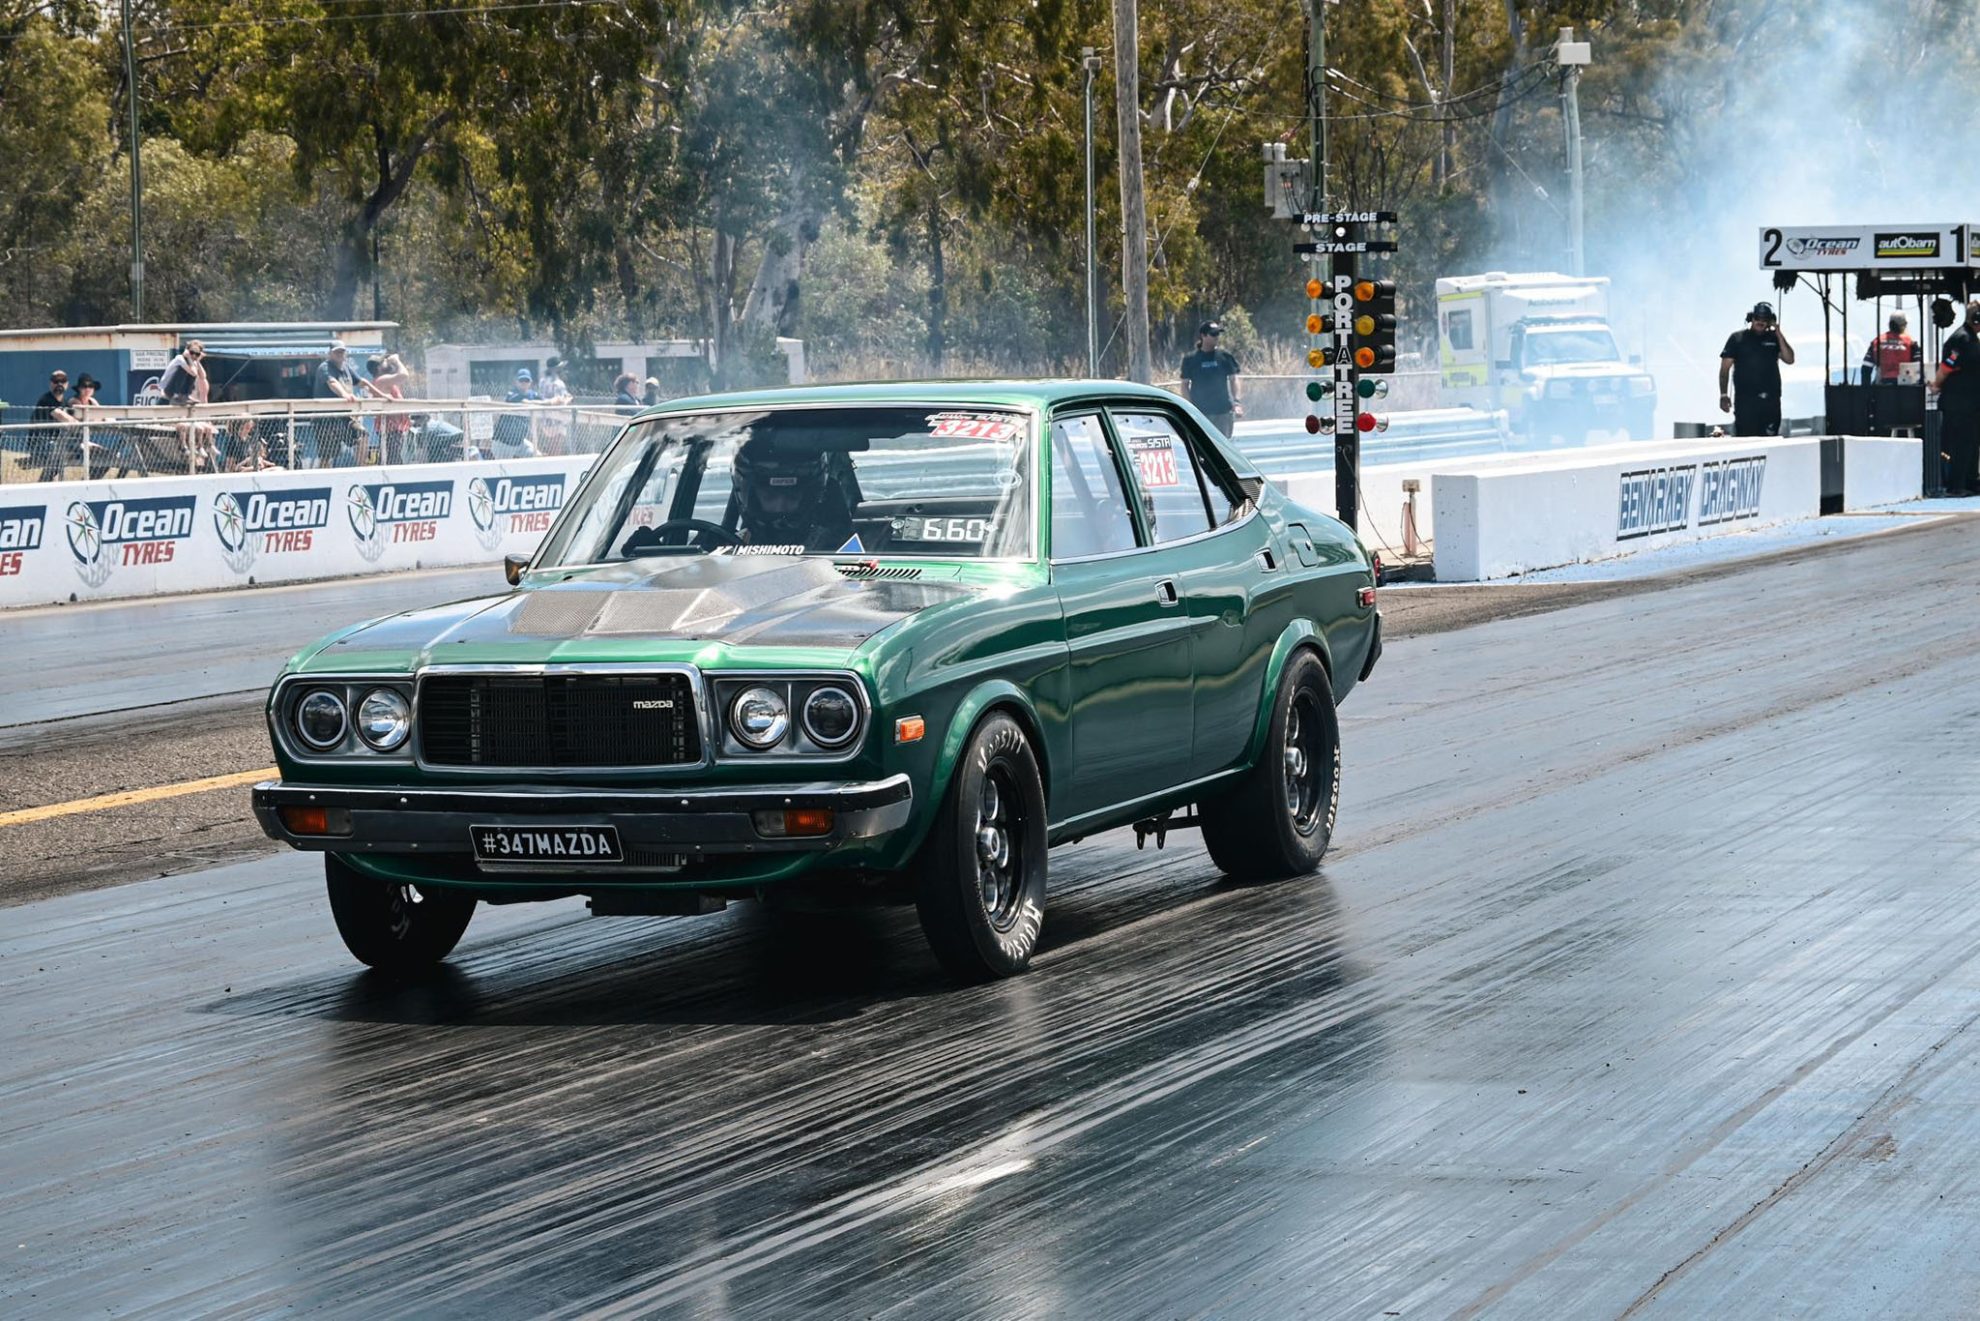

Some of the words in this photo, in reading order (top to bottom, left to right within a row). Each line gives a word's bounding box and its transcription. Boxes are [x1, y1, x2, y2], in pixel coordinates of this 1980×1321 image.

[1303, 211, 1378, 223] PRE-STAGE
[1315, 242, 1367, 253] STAGE
[1763, 228, 1783, 267] 2
[1805, 238, 1859, 250] Ocean
[1950, 225, 1965, 263] 1
[1334, 275, 1354, 434] PORTATREE
[936, 420, 1017, 441] 3213
[1140, 451, 1177, 485] 3213
[375, 486, 450, 519] Ocean
[494, 479, 563, 511] Ocean
[1698, 455, 1767, 526] DRAGWAY
[102, 503, 192, 541] Ocean
[246, 494, 327, 530] Ocean
[510, 512, 550, 534] TYRES
[0, 517, 41, 548] an
[266, 530, 313, 553] TYRES
[393, 521, 437, 543] TYRES
[923, 518, 985, 541] 6.60
[123, 541, 175, 566] TYRES
[736, 544, 805, 555] MISHIMOTO
[633, 700, 673, 709] mazda
[482, 833, 612, 855] #347MAZDA
